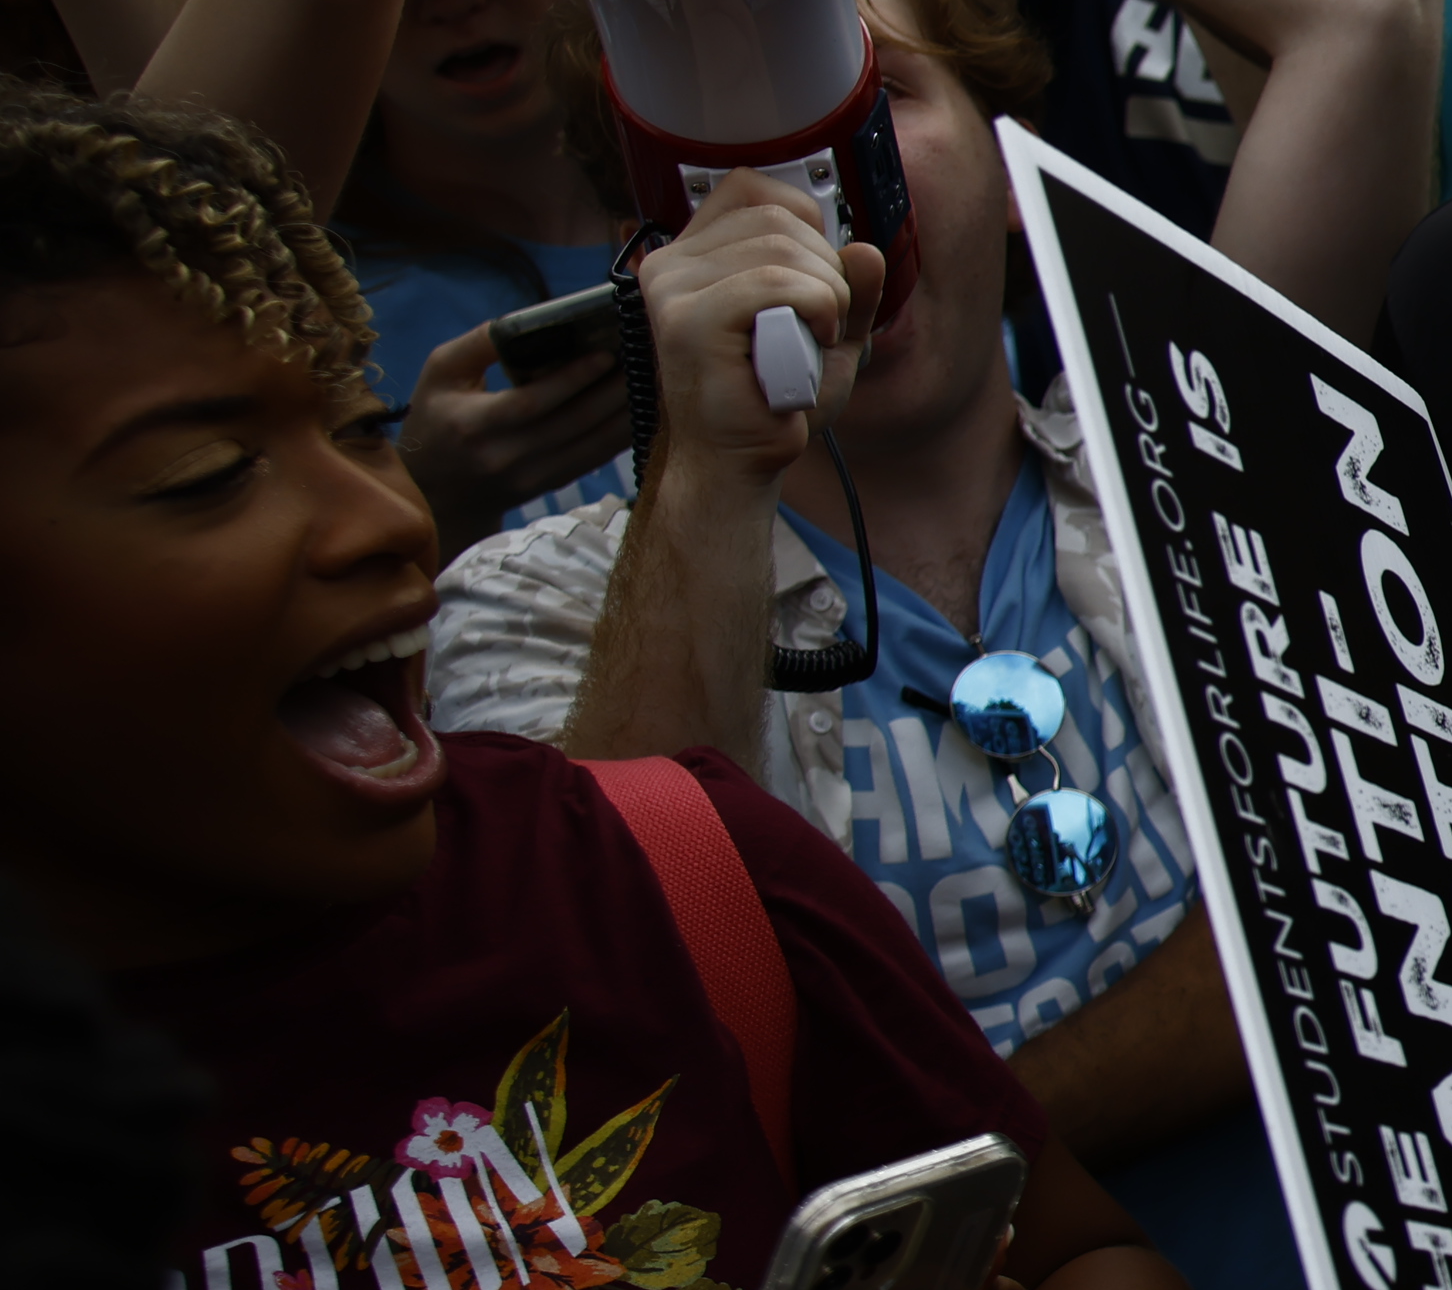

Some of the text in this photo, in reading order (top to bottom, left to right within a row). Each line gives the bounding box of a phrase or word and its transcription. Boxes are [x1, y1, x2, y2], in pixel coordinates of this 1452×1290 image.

[1167, 339, 1244, 472] IS
[1124, 381, 1365, 1189] STUDENTSFORLIFE.ORG
[1211, 511, 1408, 1069] FUTURE
